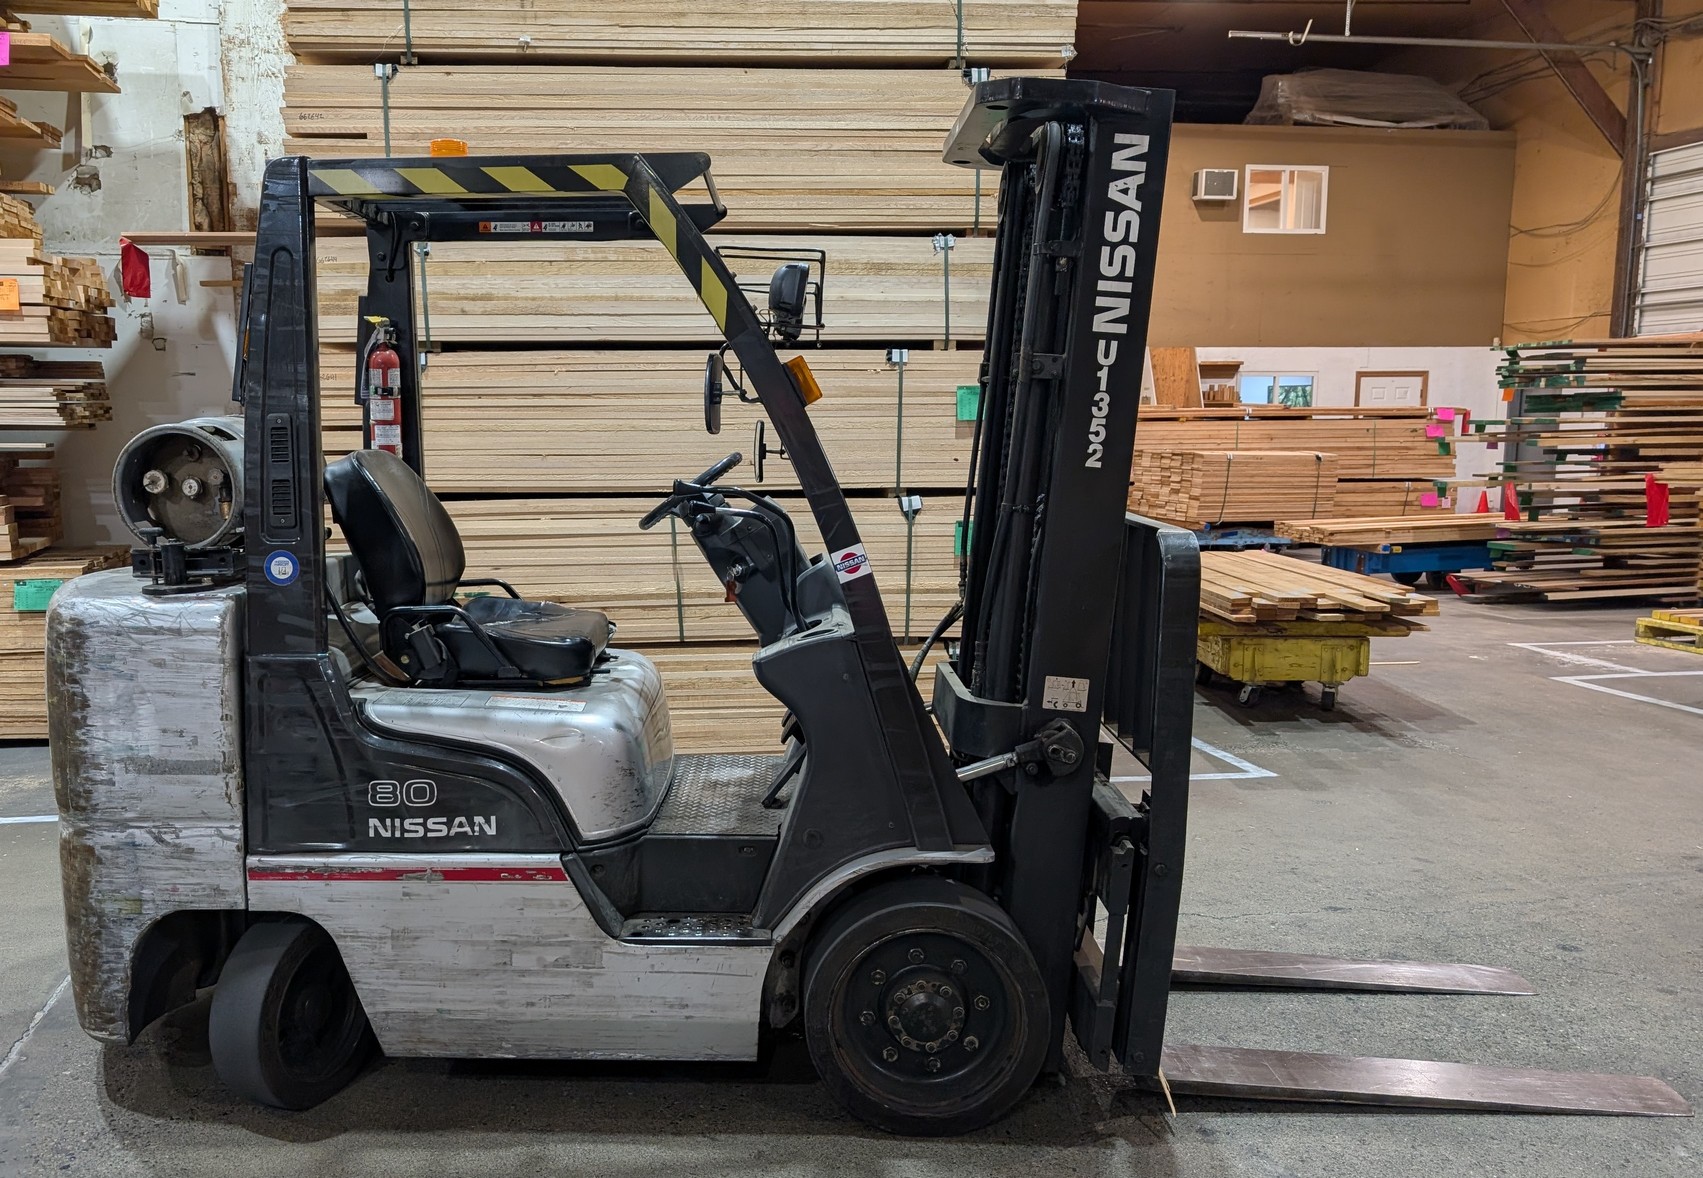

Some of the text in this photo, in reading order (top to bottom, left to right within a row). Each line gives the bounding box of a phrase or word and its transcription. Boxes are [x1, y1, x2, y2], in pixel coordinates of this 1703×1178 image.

[1092, 132, 1150, 334] NISSAN
[1084, 339, 1119, 469] U1352
[836, 555, 865, 571] NISSAN
[367, 779, 438, 807] 80
[368, 815, 497, 838] NISSAN
